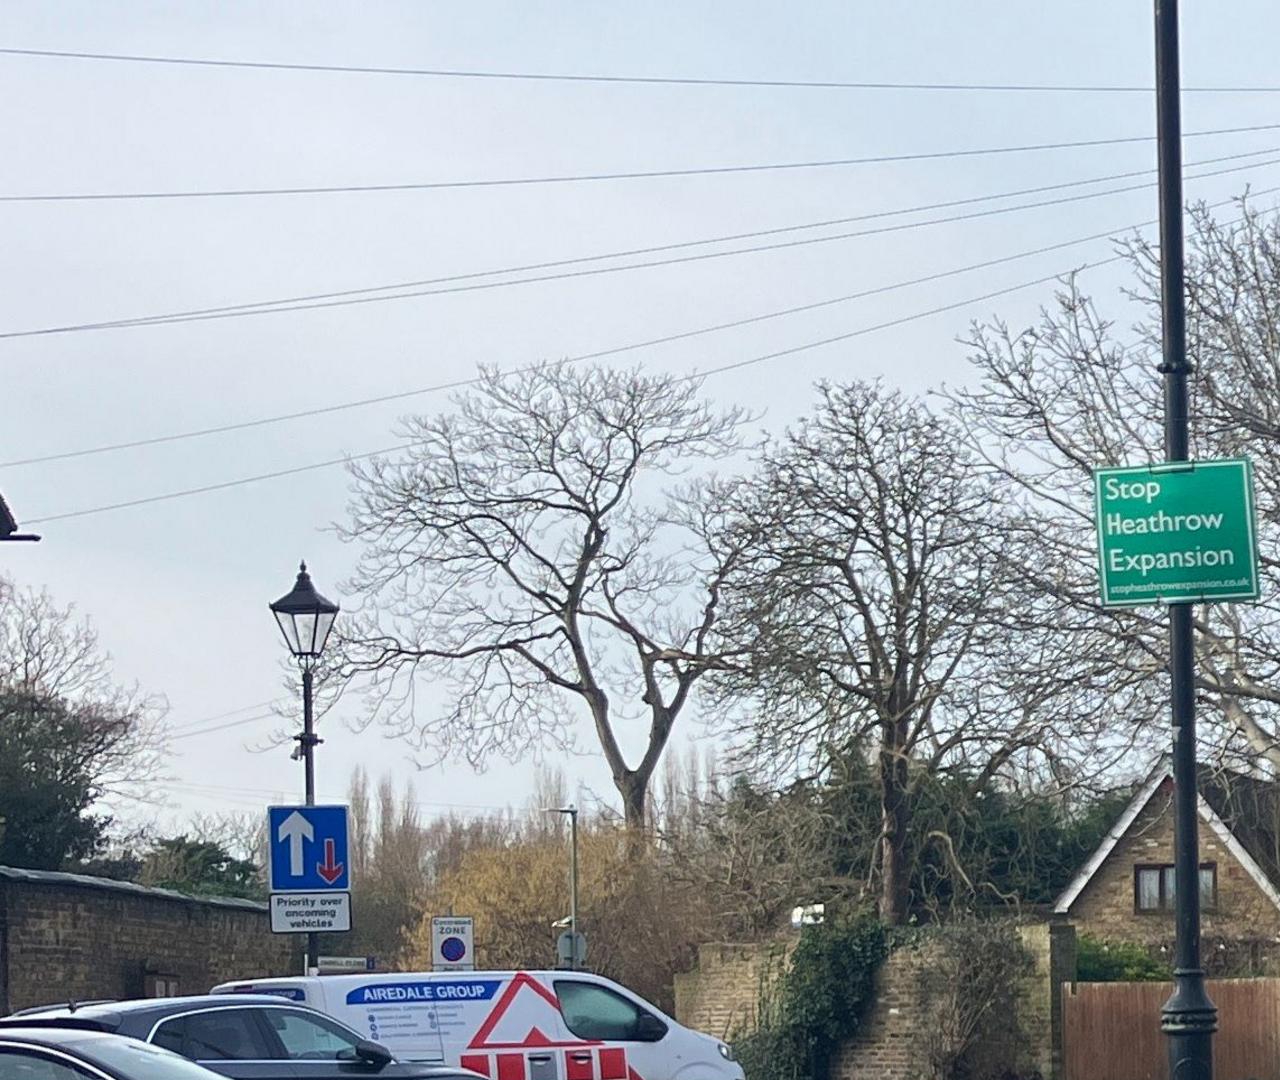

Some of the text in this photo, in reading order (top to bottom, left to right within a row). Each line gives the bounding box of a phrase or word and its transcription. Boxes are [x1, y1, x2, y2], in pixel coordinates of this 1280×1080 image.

[1105, 478, 1160, 503] Stop
[1106, 510, 1223, 535] Heathrow
[1109, 546, 1234, 576] Expansion
[1110, 577, 1249, 595] stopheathrowexpansion.co.uk
[277, 897, 342, 908] Priority over
[285, 909, 337, 918] oncoming
[290, 919, 333, 928] vehicles
[439, 926, 466, 934] ZONE
[363, 985, 486, 1001] AIREDALE GROUP
